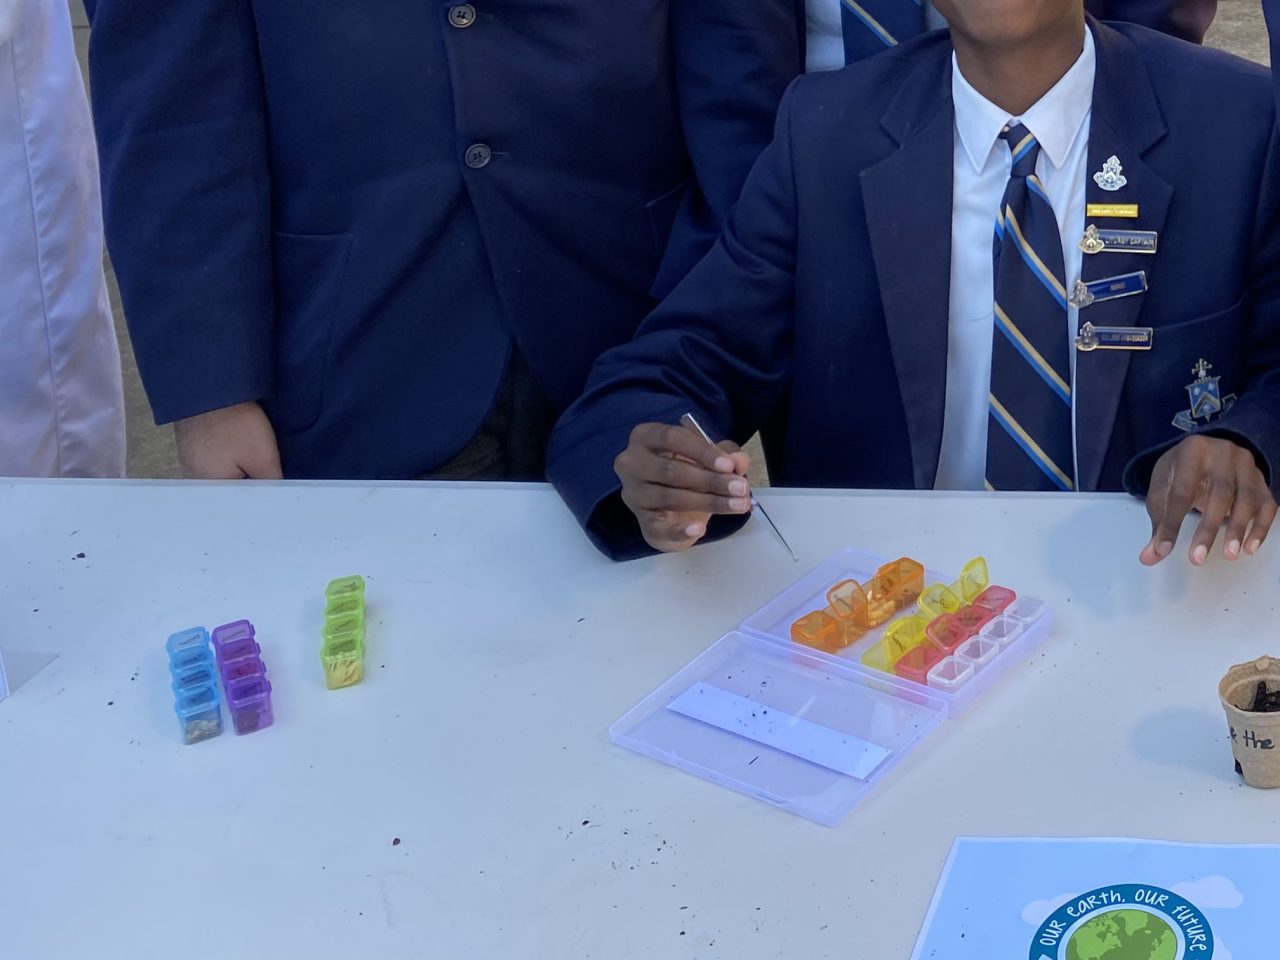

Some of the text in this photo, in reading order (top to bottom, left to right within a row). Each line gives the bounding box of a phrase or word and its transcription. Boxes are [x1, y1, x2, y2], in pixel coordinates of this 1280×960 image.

[1243, 730, 1275, 749] the
[1040, 920, 1066, 945] OUR
[1135, 889, 1168, 907] OUR
